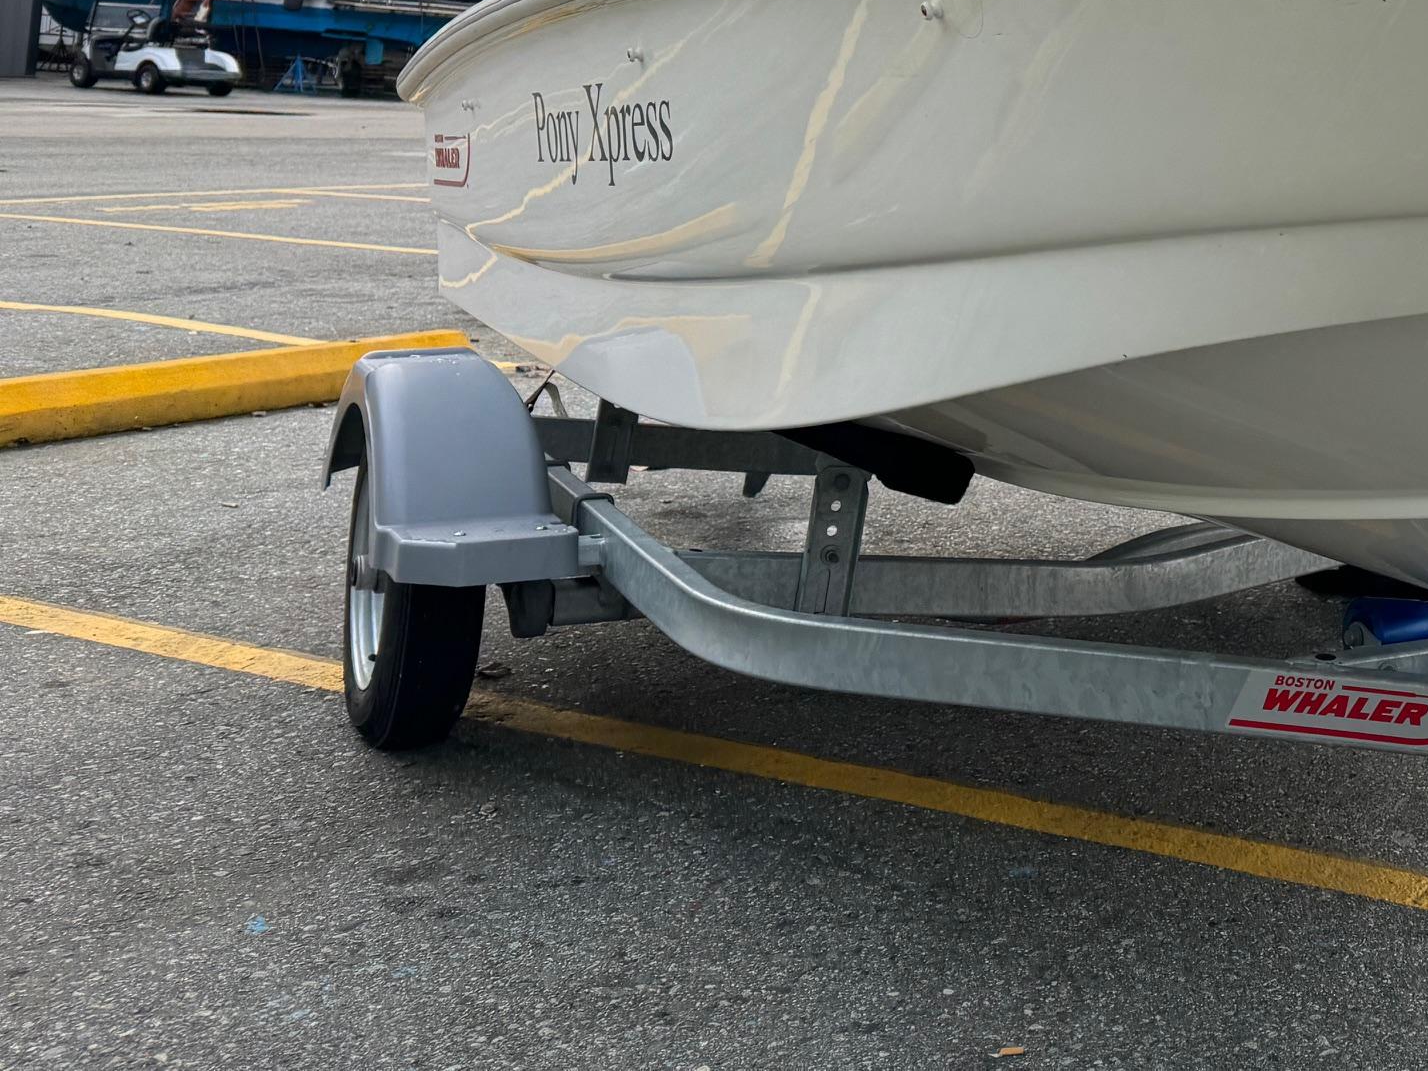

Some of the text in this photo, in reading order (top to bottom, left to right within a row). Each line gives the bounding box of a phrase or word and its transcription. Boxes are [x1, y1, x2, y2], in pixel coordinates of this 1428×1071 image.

[532, 83, 674, 187] Pony Xpress
[1274, 675, 1336, 691] BOSTON
